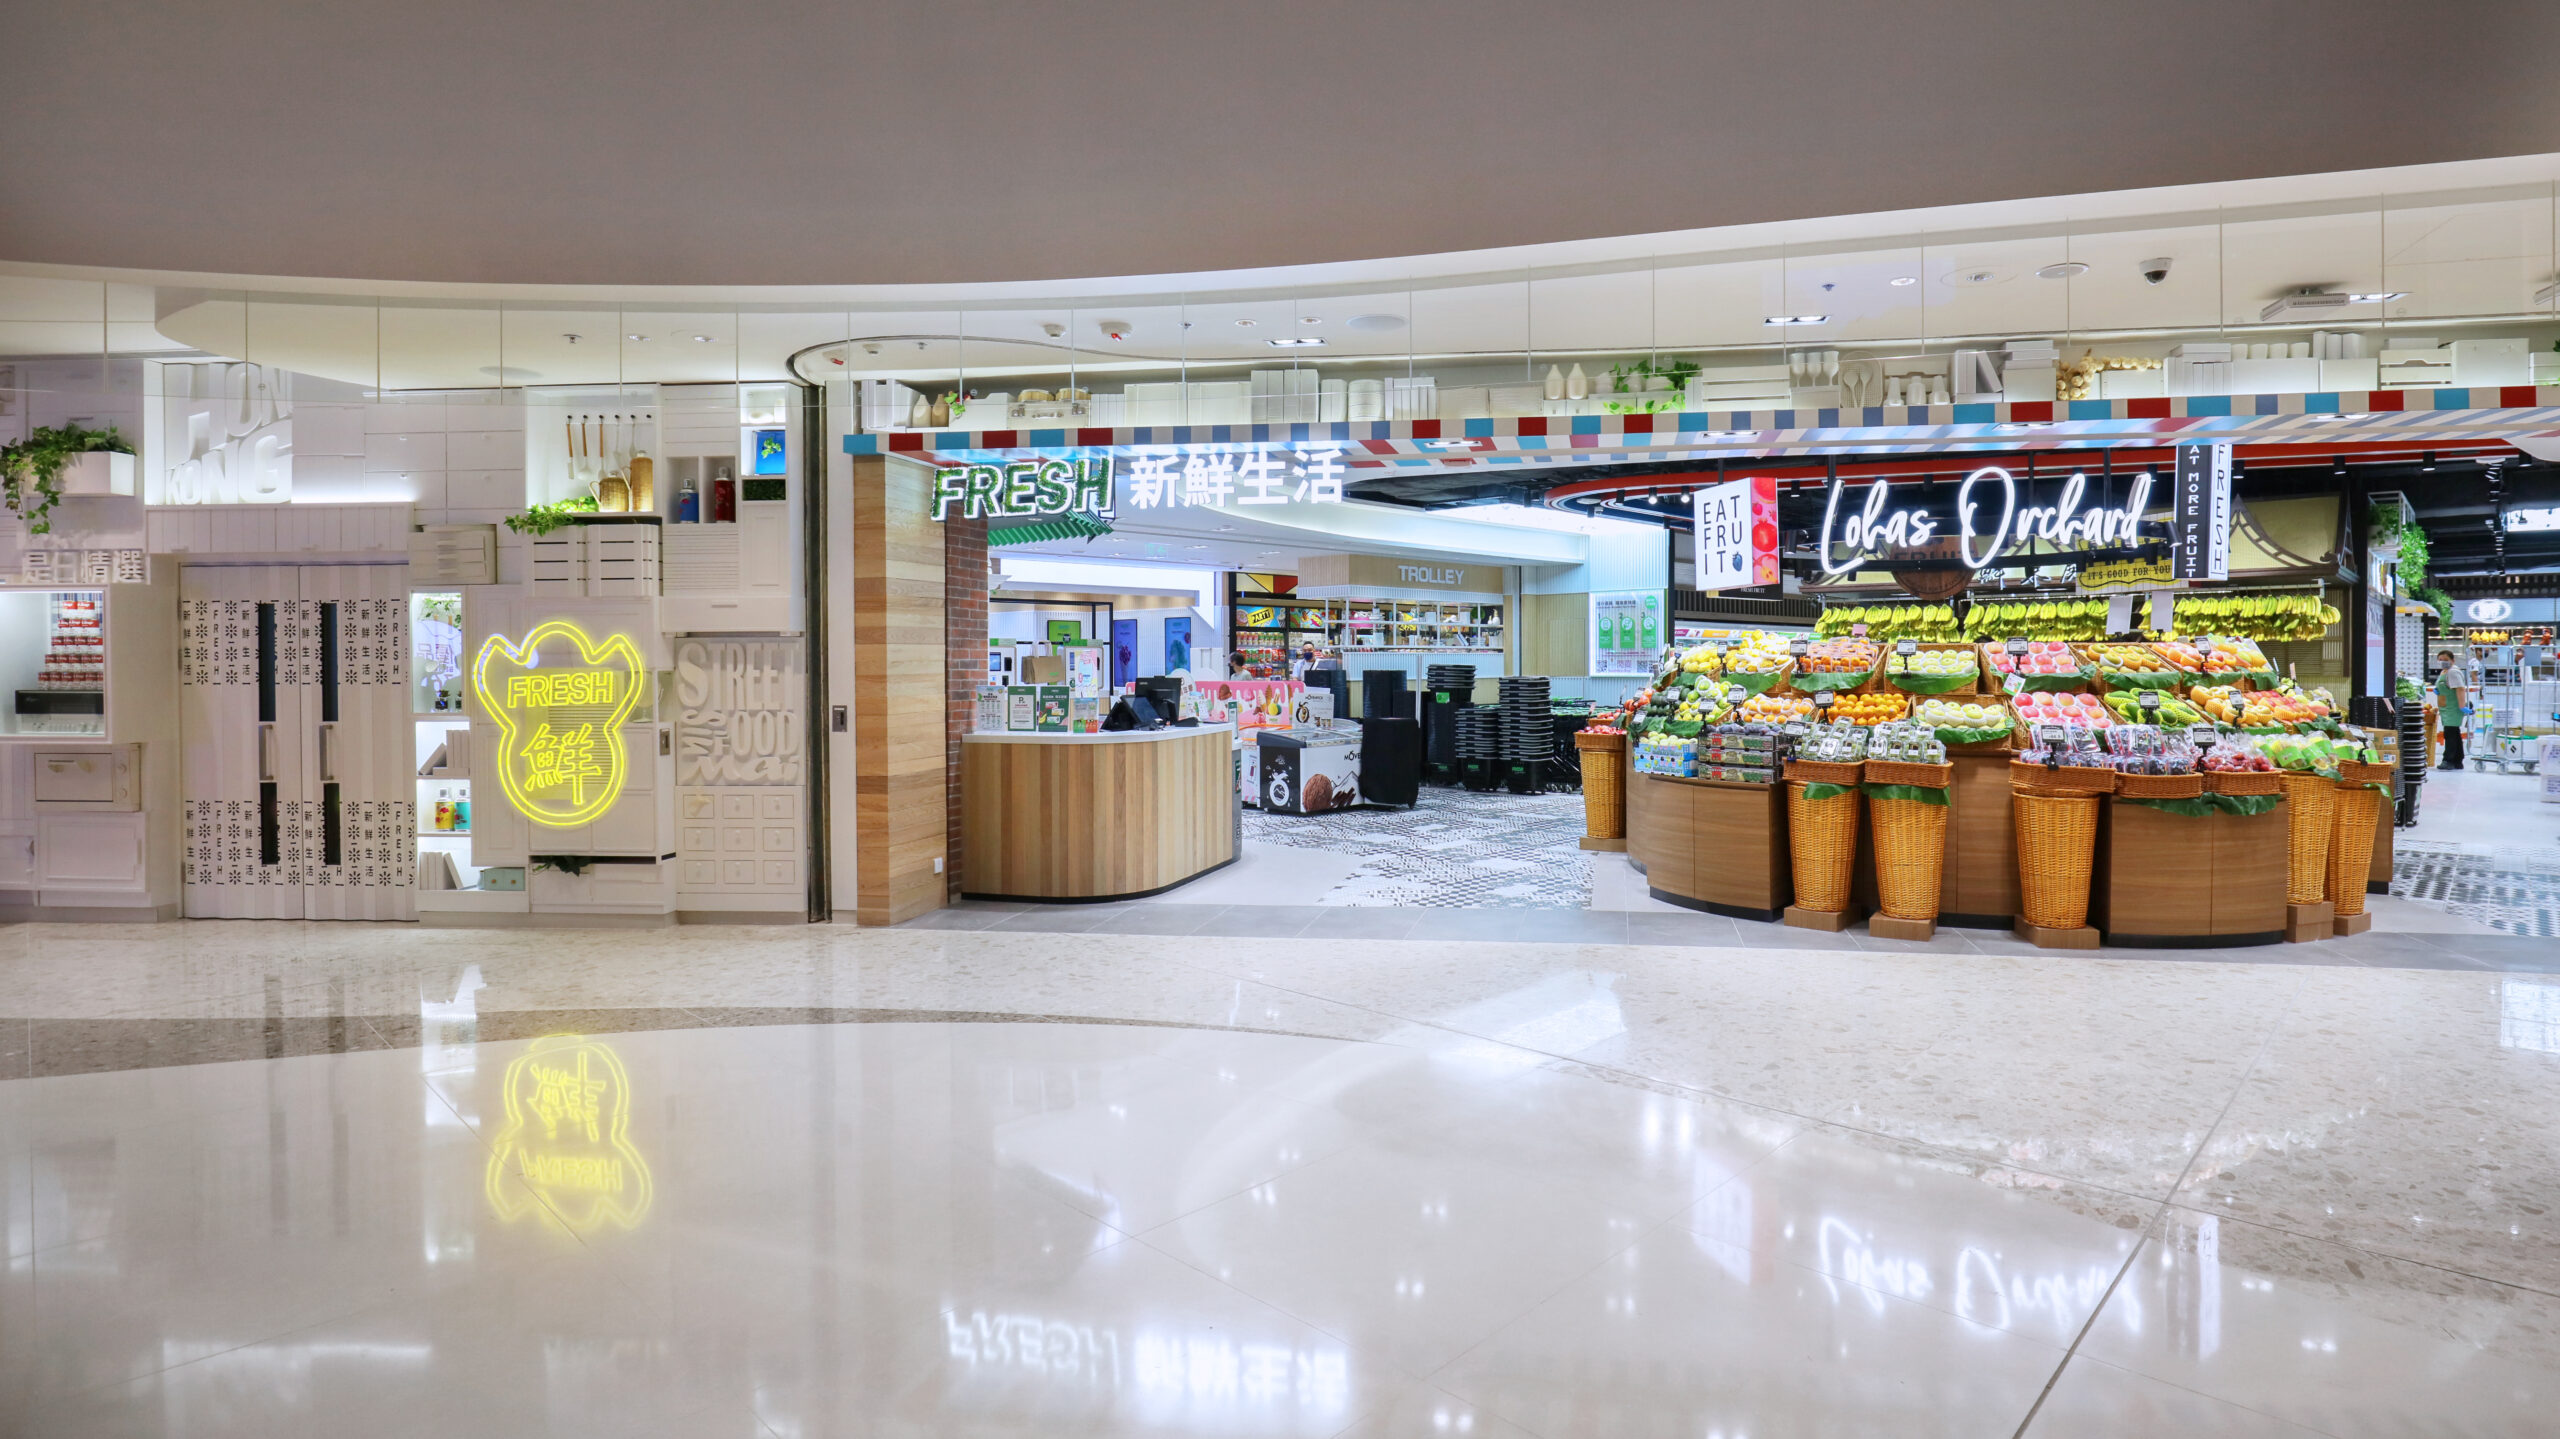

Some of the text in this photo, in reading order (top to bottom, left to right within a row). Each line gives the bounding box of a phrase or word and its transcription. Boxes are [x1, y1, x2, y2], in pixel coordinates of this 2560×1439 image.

[931, 449, 1345, 522] FRESH 新鮮生活
[1703, 494, 1740, 525] EAT
[2187, 472, 2200, 516] MORE
[2214, 444, 2226, 572] FRESH
[1959, 466, 2151, 569] Orchard
[1397, 564, 1465, 585] TROLLEY
[2106, 568, 2129, 579] GOOD
[2132, 565, 2149, 577] FOR
[2153, 564, 2171, 575] YOU
[2185, 523, 2199, 578] FRUIT
[507, 671, 614, 709] FRESH
[678, 642, 799, 711] STREET
[520, 723, 602, 806] 鮮
[395, 810, 403, 877] FRESH
